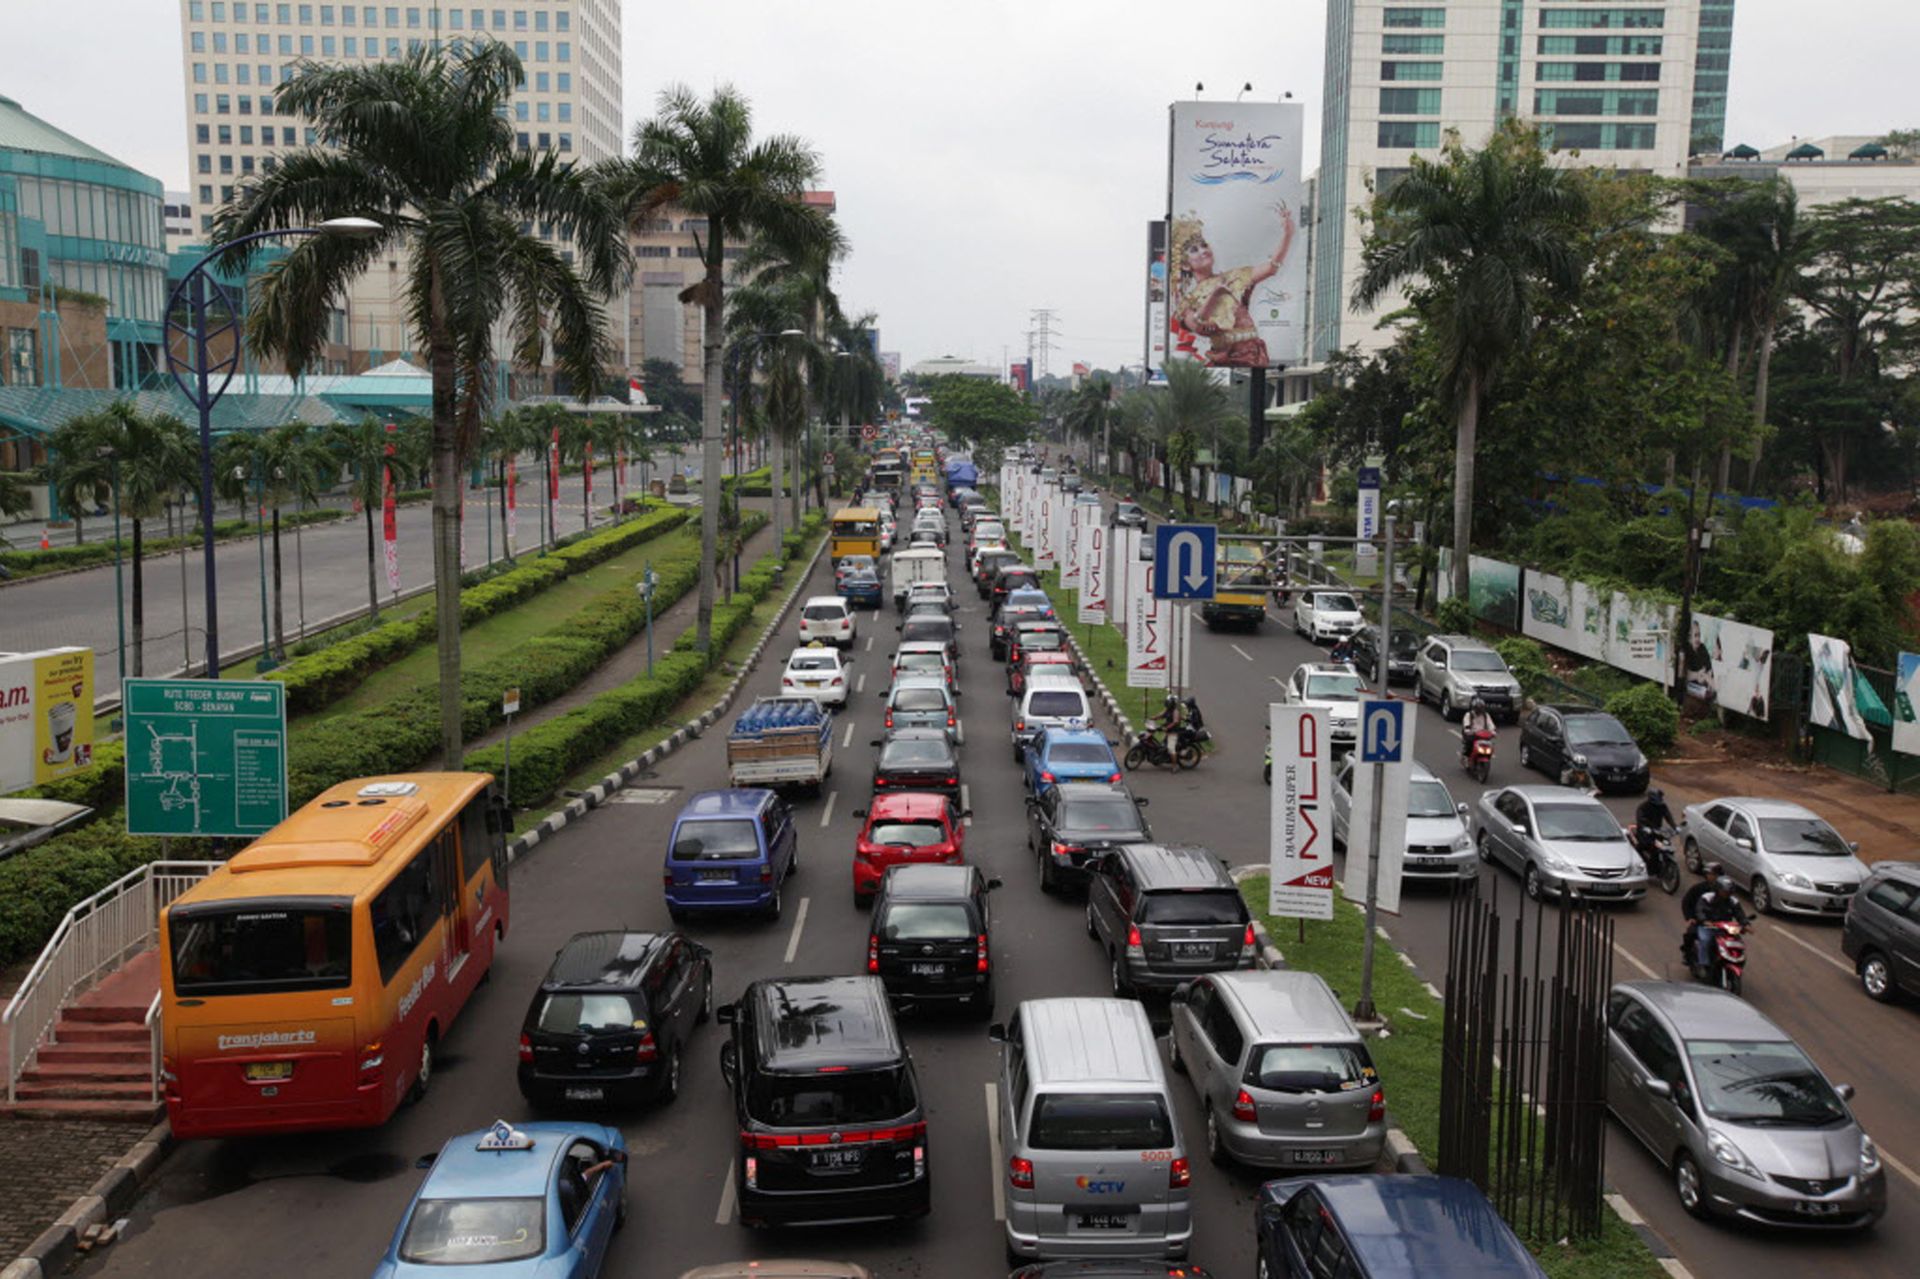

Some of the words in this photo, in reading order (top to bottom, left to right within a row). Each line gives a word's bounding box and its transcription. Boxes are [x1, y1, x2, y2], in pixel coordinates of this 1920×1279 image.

[1200, 132, 1282, 153] Sumatera
[1203, 148, 1265, 168] Selatan
[186, 689, 212, 700] FEEDER
[1299, 713, 1318, 859] MLD
[1303, 873, 1332, 887] NEW
[217, 1030, 316, 1050] transjakarta
[1087, 1181, 1126, 1194] SCTV
